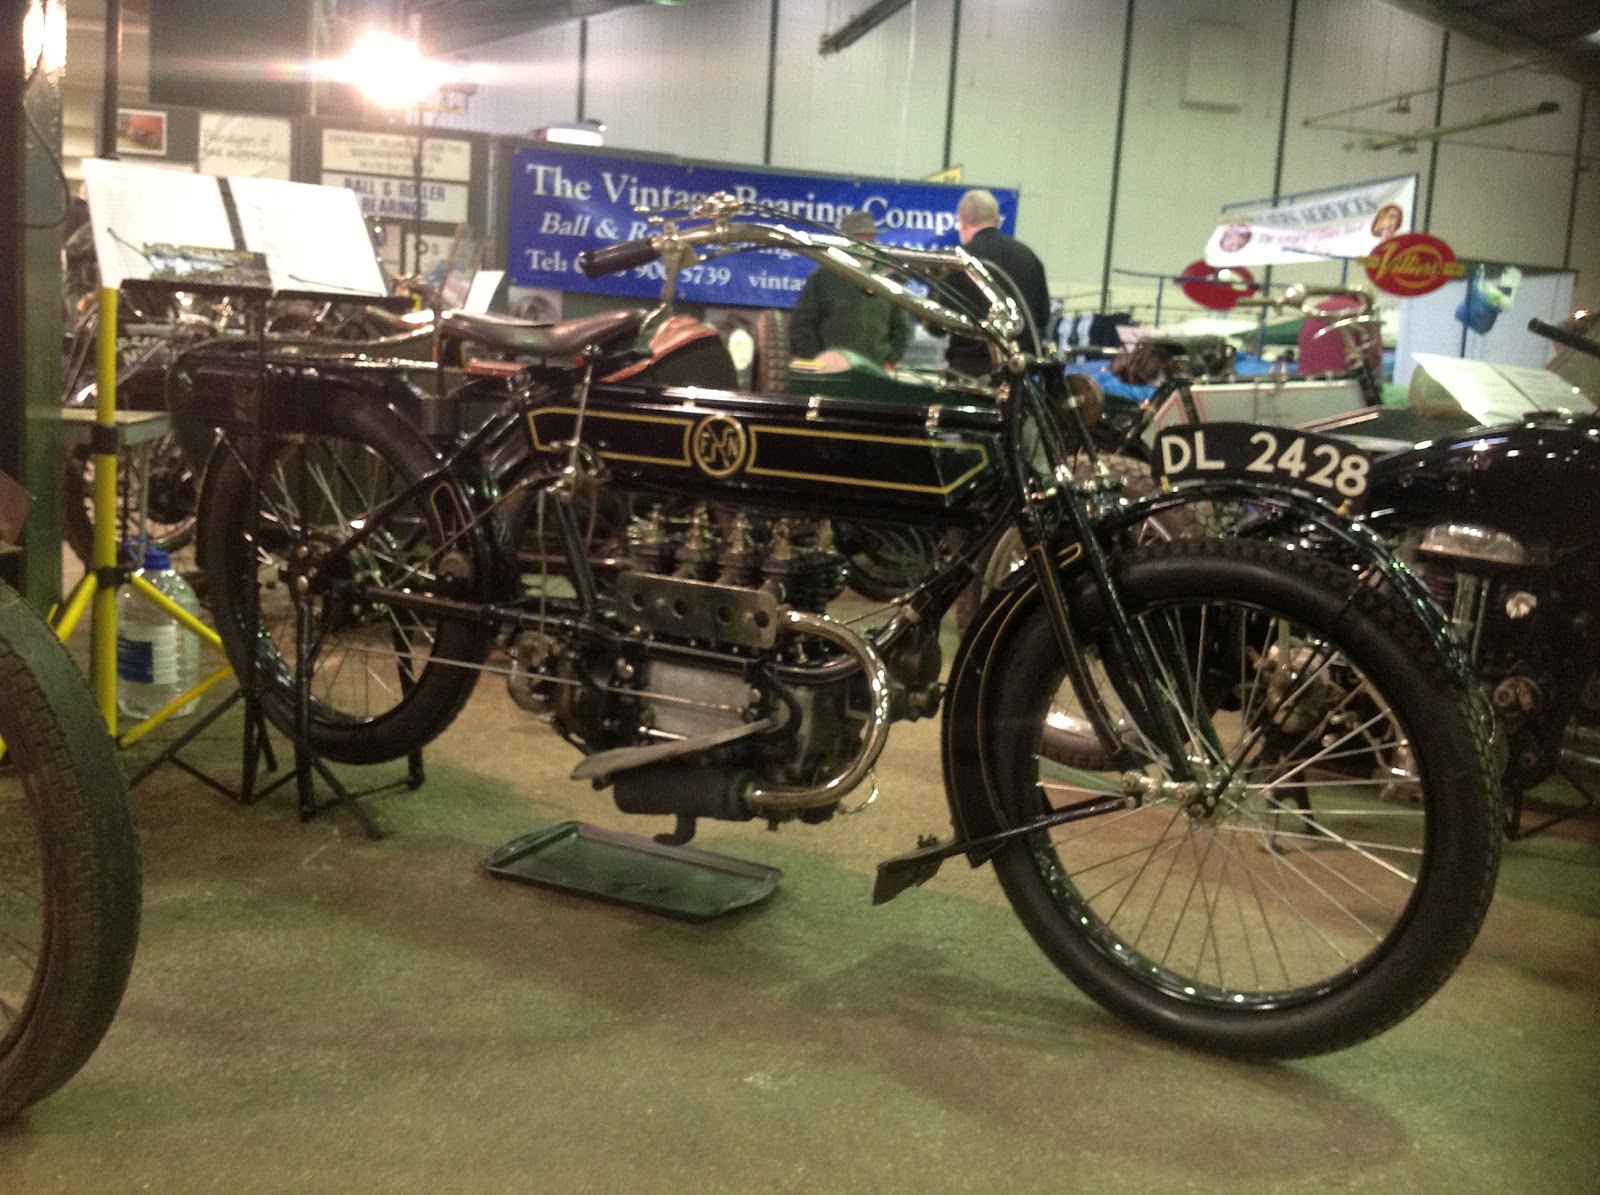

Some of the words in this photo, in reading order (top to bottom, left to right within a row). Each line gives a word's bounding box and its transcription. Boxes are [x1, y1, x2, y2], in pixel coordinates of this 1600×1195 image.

[525, 162, 592, 201] The
[540, 212, 590, 237] Ball
[594, 217, 620, 241] &
[525, 248, 567, 272] Tel:
[680, 265, 732, 286] 5739
[1161, 430, 1226, 475] DL
[1246, 431, 1371, 498] 2428
